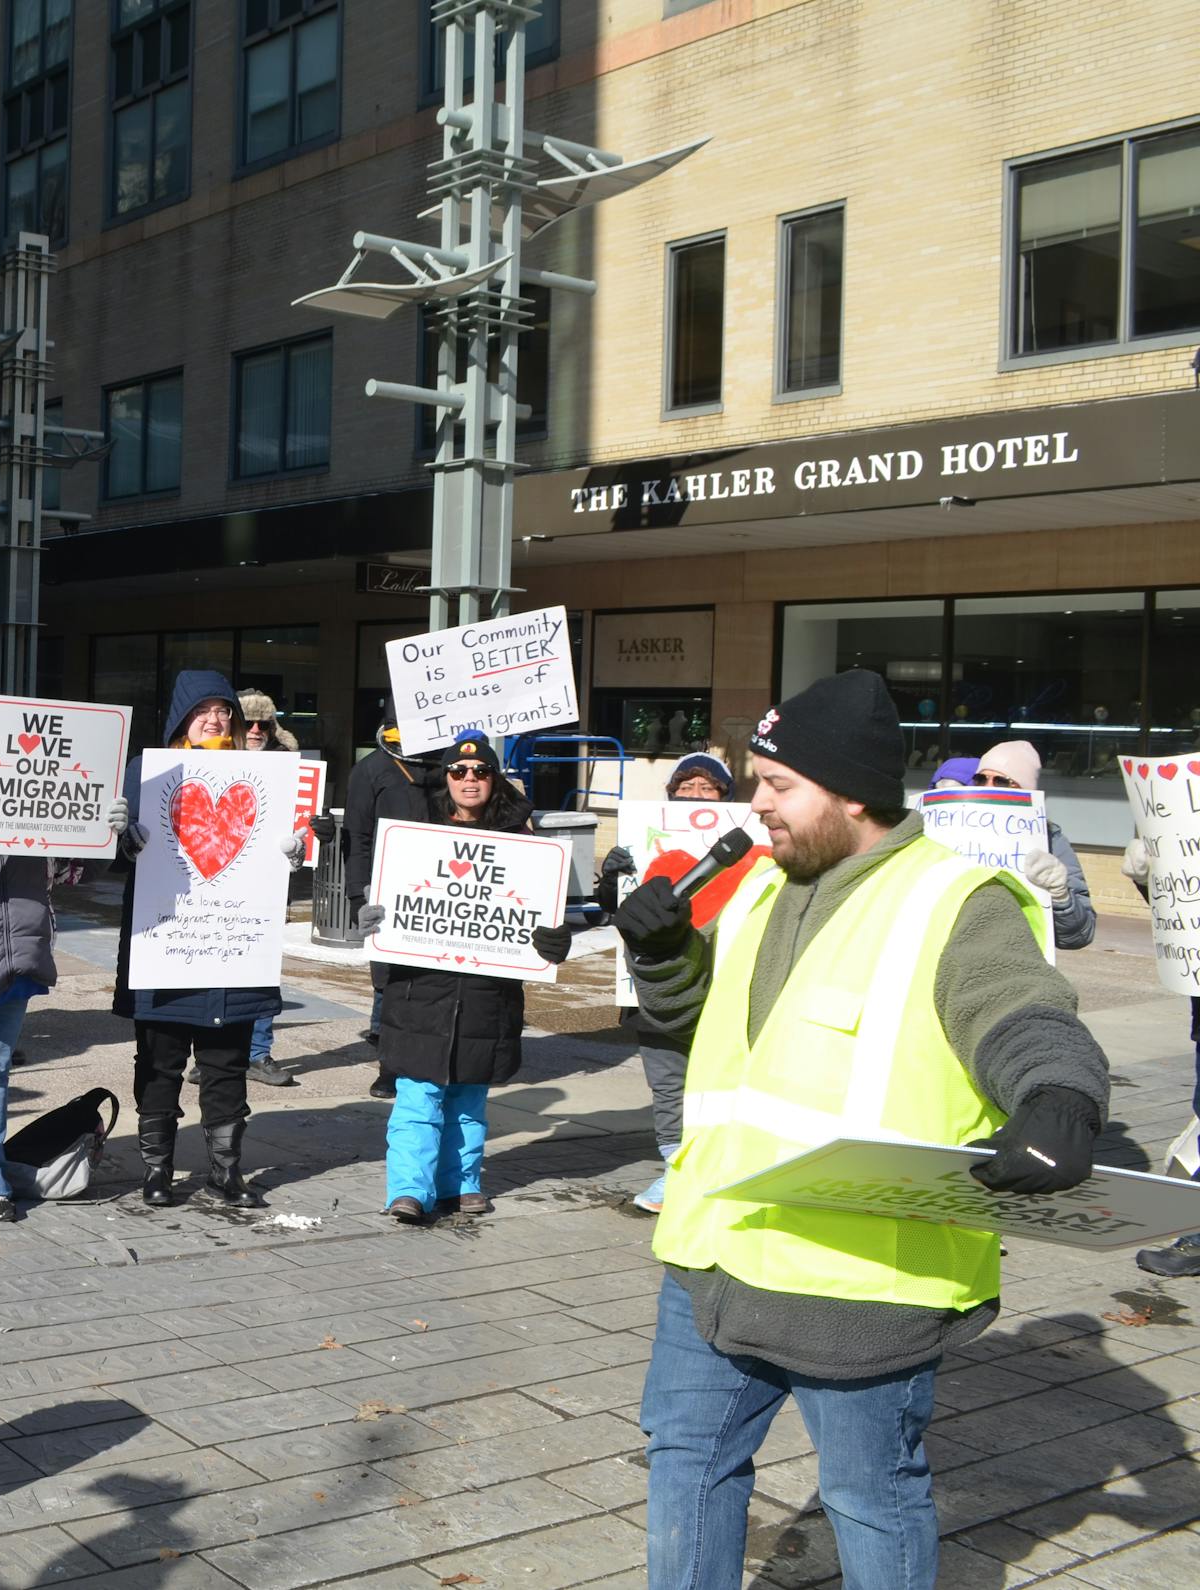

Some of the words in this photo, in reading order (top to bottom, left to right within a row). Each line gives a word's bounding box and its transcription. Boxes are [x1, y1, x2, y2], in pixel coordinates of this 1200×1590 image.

[571, 483, 628, 514] THE
[642, 466, 776, 506] KAHLER
[793, 450, 924, 490] GRAND
[941, 432, 1079, 477] HOTEL
[402, 642, 445, 663] Our
[460, 612, 563, 649] Community
[617, 637, 686, 655] LASKER
[425, 665, 446, 682] is
[471, 639, 555, 672] BETTER
[413, 682, 502, 710] Because
[524, 663, 551, 685] of
[22, 712, 64, 735] WE
[423, 685, 574, 741] Immigrants!
[16, 757, 60, 777] OUR
[1136, 781, 1172, 818] We
[453, 840, 496, 863] WE
[956, 841, 1025, 874] ithout
[176, 893, 194, 907] We
[199, 894, 221, 908] love
[224, 899, 246, 909] our
[446, 881, 493, 901] OUR
[157, 912, 213, 929] immigrant
[394, 894, 543, 928] IMMIGRANT
[142, 925, 158, 939] We
[166, 930, 197, 941] stand
[199, 932, 212, 943] up
[213, 931, 225, 942] to
[227, 931, 265, 944] protect
